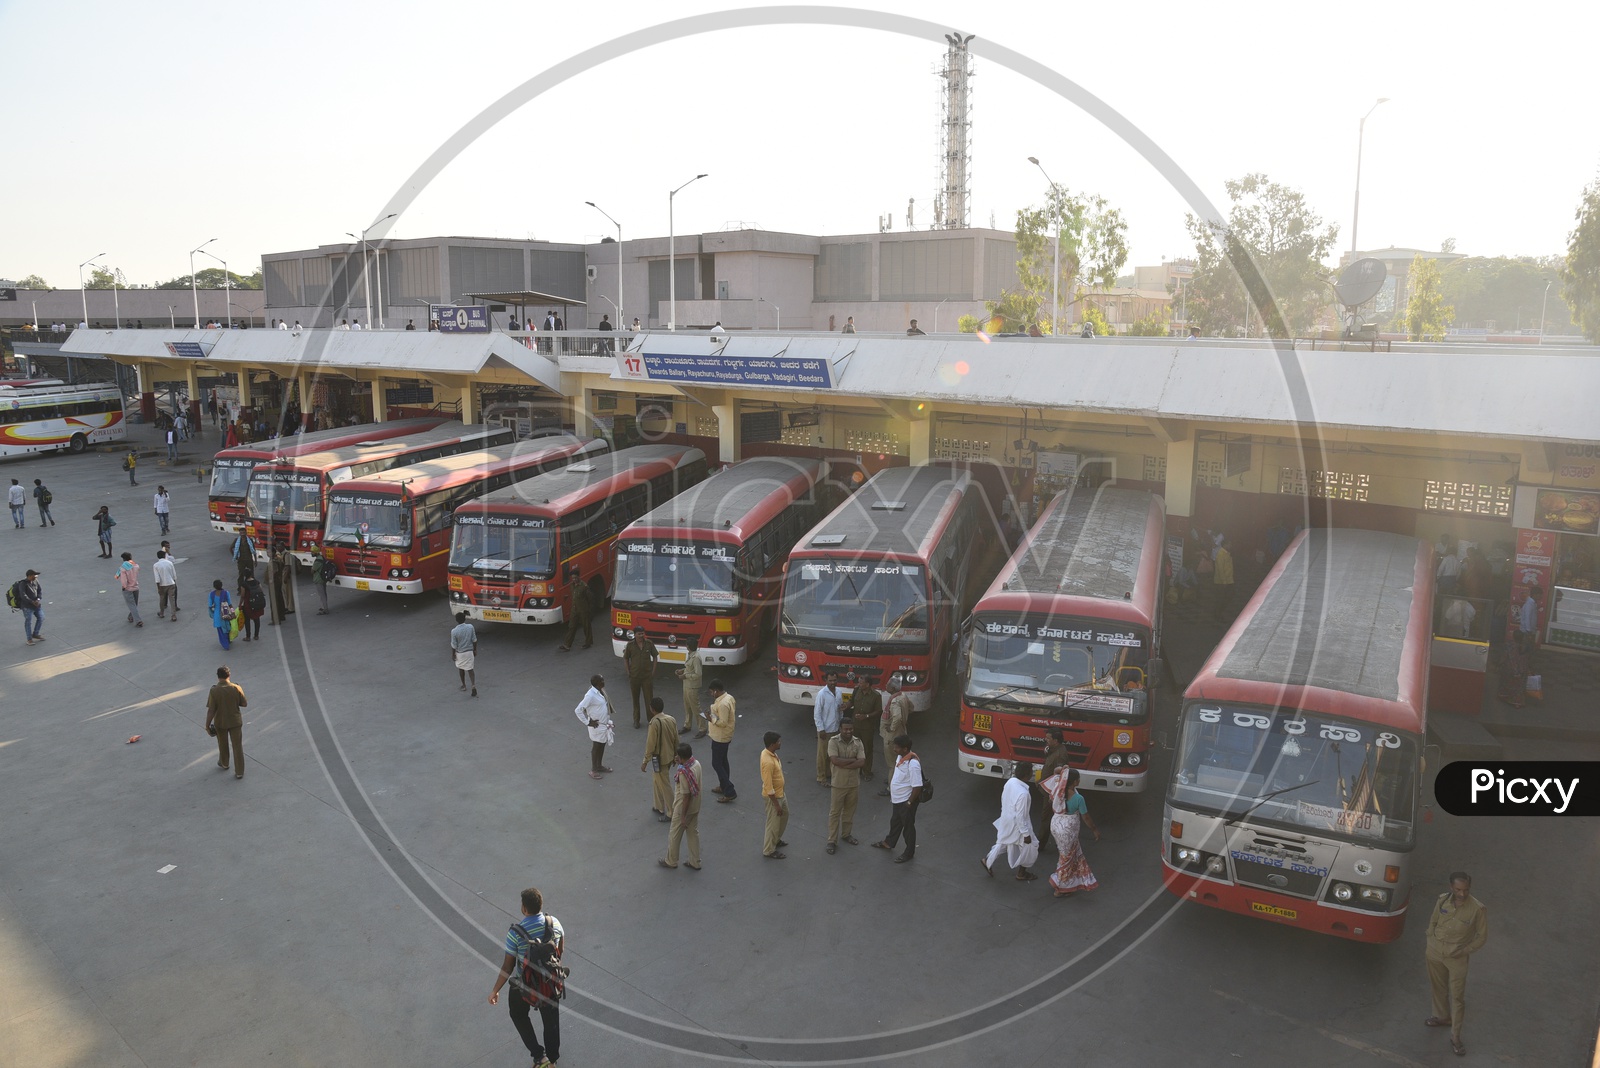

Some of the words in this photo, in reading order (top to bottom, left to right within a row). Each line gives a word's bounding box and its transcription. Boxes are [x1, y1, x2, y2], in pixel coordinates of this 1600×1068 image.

[459, 312, 465, 325] 1
[472, 310, 480, 318] BUS
[468, 320, 486, 328] TERMINAL
[625, 358, 640, 372] 17
[648, 368, 668, 376] Towards
[669, 369, 687, 378] Ballary,
[744, 372, 772, 381] Gulbarga,
[772, 373, 798, 382] Yadagiri,
[798, 374, 824, 382] Beedara
[460, 516, 484, 525] ಈಶಾನ್ಯ
[488, 518, 518, 526] ಕರ್ನಾಟಕ
[522, 520, 545, 528] ಸಾರಿಗೆ
[661, 544, 695, 555] ಕರ್ನಾಟಕ
[702, 547, 726, 557] ಸಾರಿಗೆ
[805, 563, 832, 574] ಈಶಾನ್ಯ
[835, 564, 868, 573] ಕರ್ನಾಟಕ
[874, 566, 899, 574] ಸಾರಿಗೆ
[986, 622, 1030, 637] ಈಶಾನ್ಯ
[1037, 626, 1092, 641] ಕರ್ನಾಟಕ
[1200, 706, 1222, 723] ಕ
[1233, 713, 1270, 729] ರಾ
[1320, 724, 1361, 742] ಸಾ
[1376, 732, 1401, 749] ನಿ
[1243, 844, 1314, 864] EICHER
[1231, 850, 1283, 868] ಕರ್ನಾಟಕ
[1291, 862, 1328, 878] ಸಾರಿಗೆ
[1254, 904, 1272, 912] KA-17
